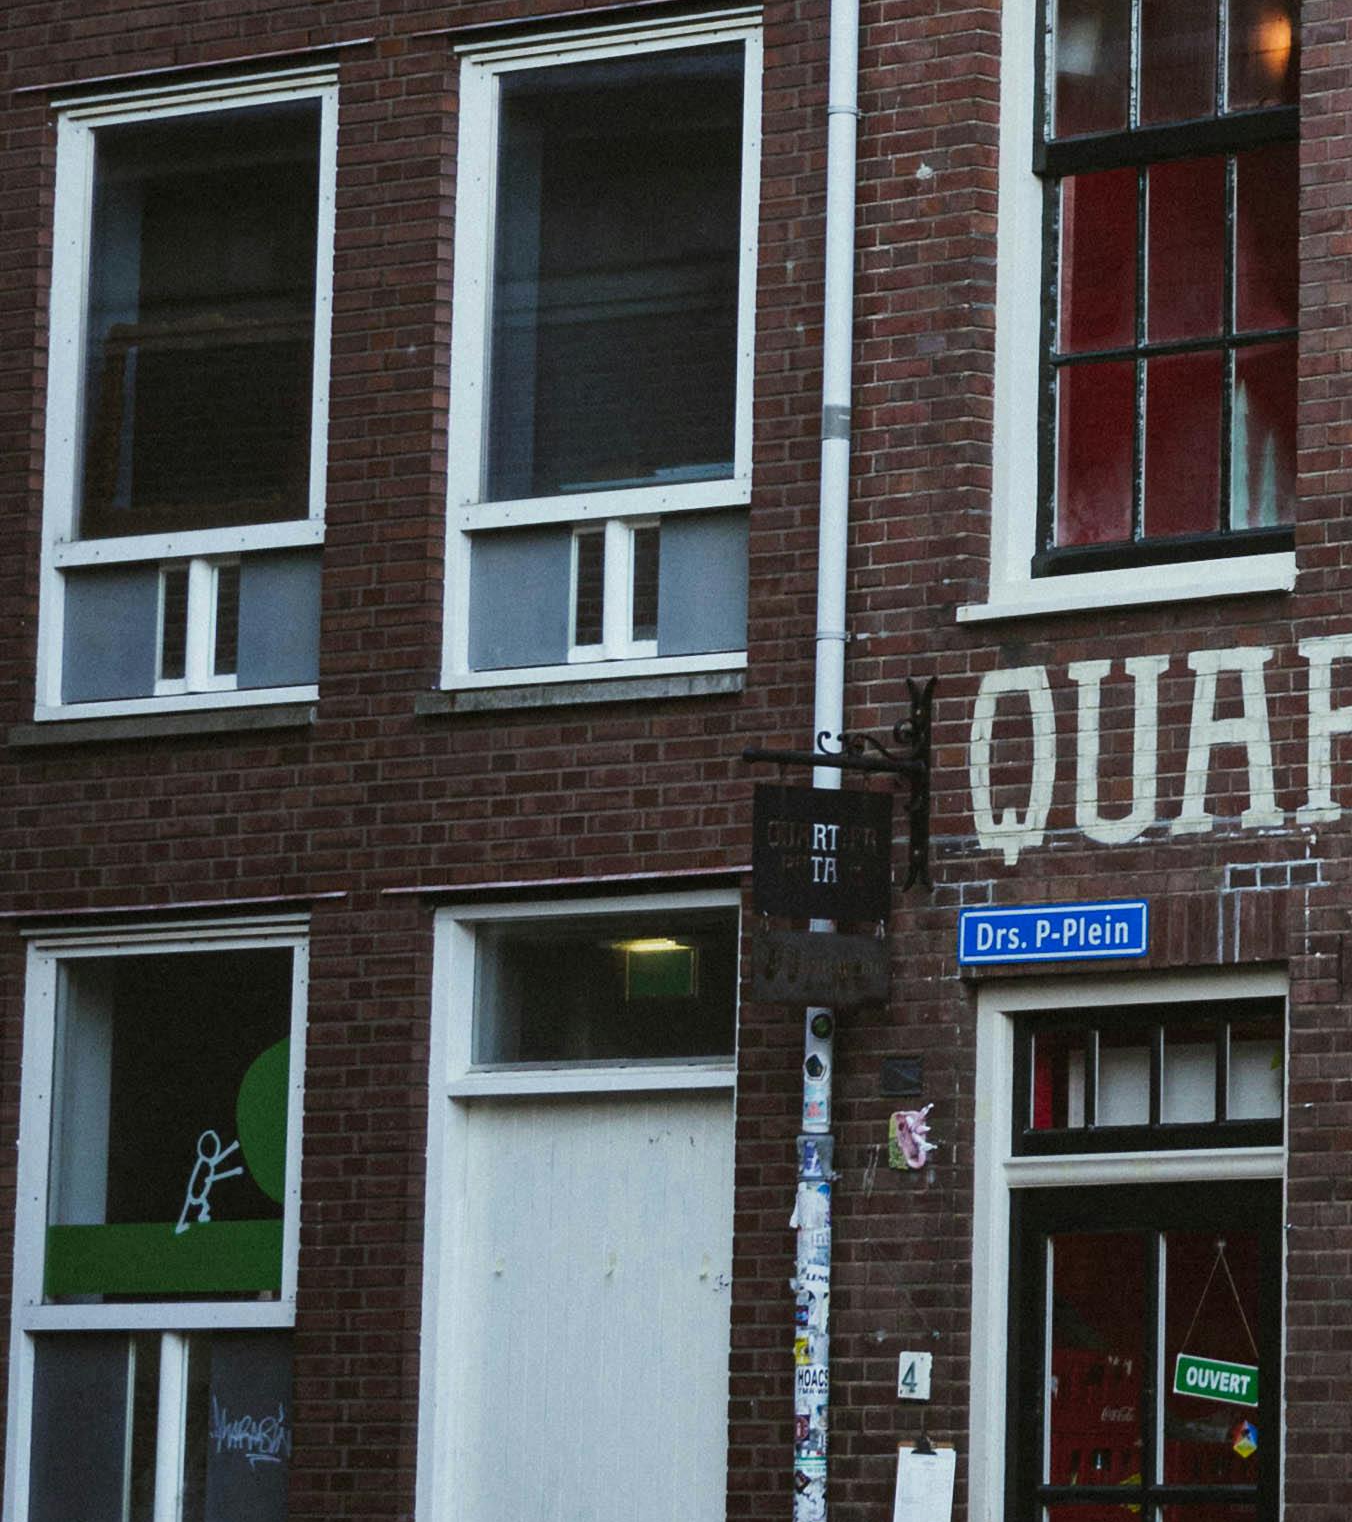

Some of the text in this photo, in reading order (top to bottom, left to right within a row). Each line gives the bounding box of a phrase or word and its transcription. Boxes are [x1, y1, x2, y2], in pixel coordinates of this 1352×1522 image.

[976, 914, 1129, 951] Drs. P-Plein
[901, 1361, 918, 1393] 4
[1185, 1366, 1251, 1395] OUVERT
